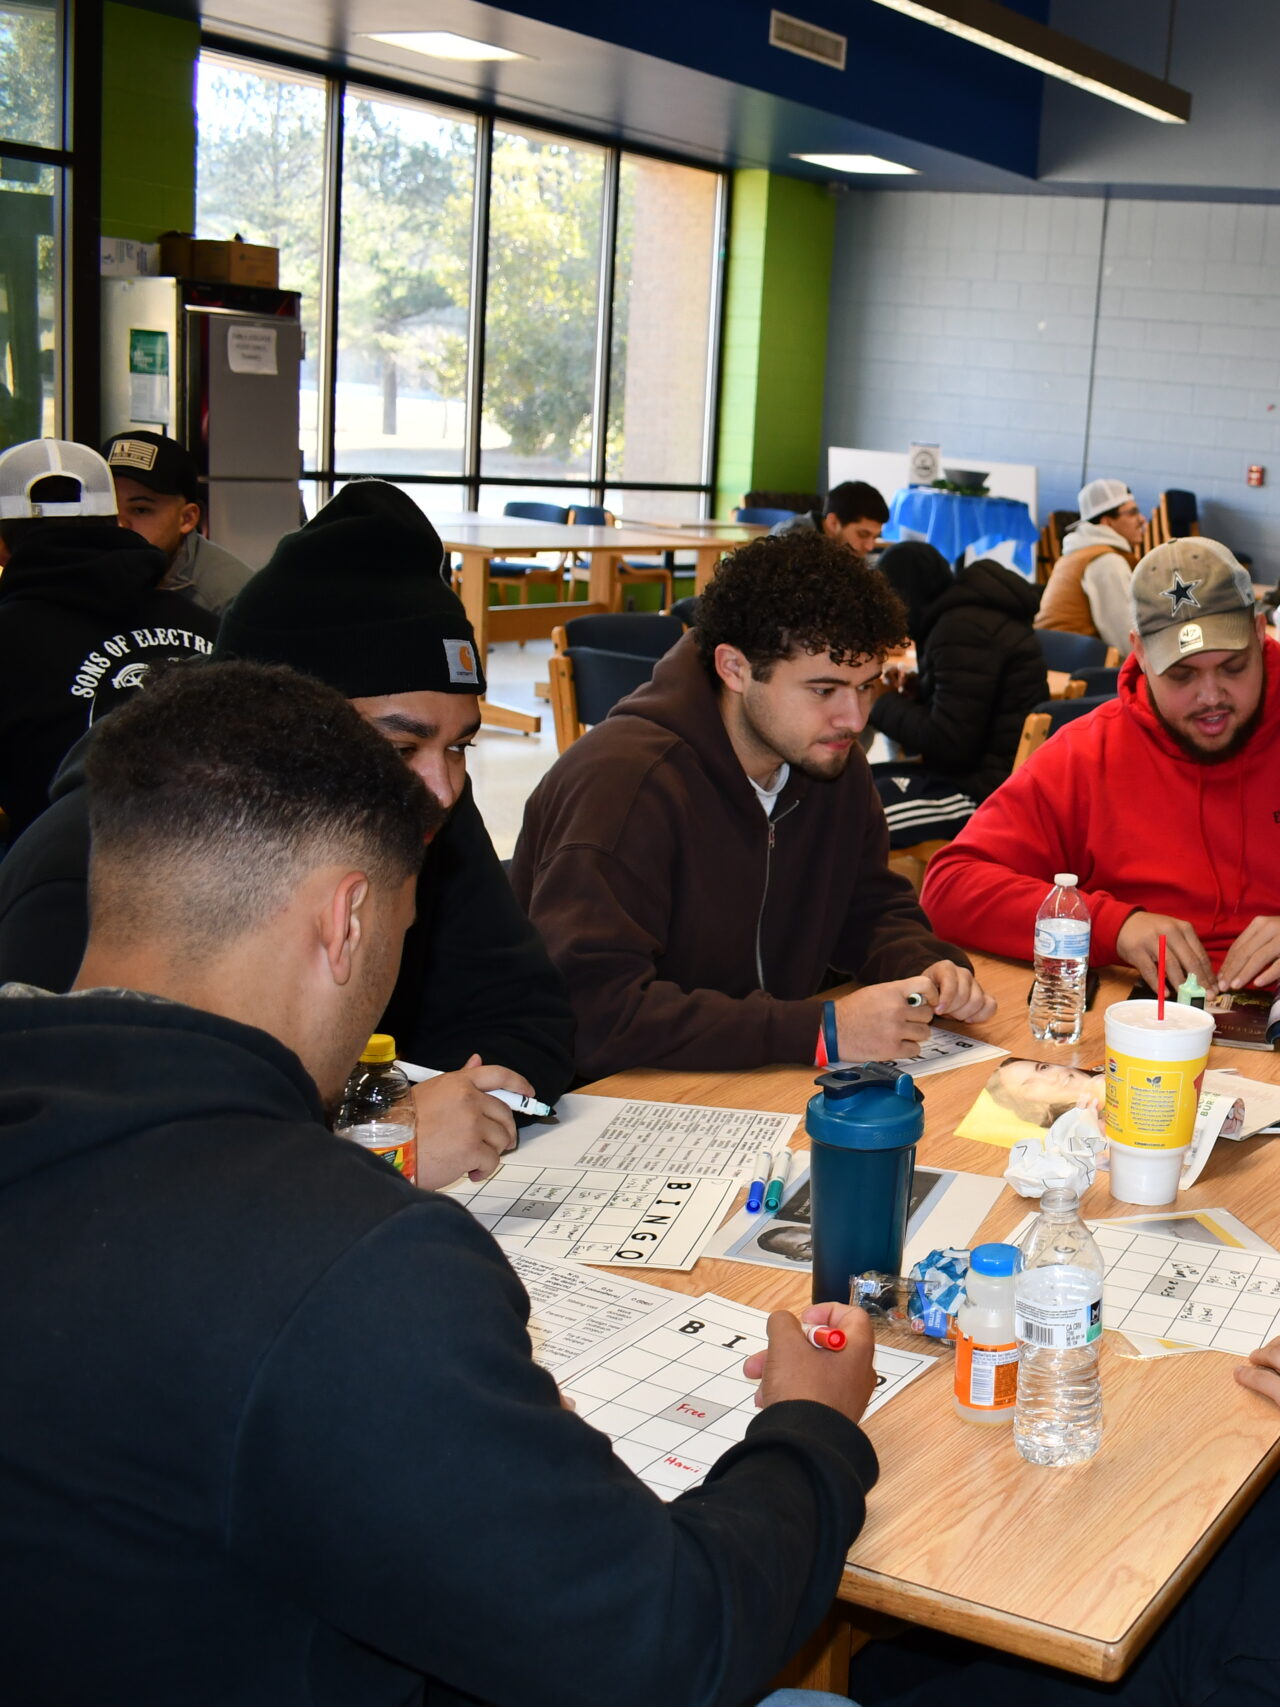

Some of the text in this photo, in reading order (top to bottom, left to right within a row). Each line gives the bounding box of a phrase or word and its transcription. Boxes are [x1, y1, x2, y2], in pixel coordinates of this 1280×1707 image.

[71, 652, 111, 698] SONS
[104, 635, 131, 657] OF
[676, 1403, 706, 1418] Free
